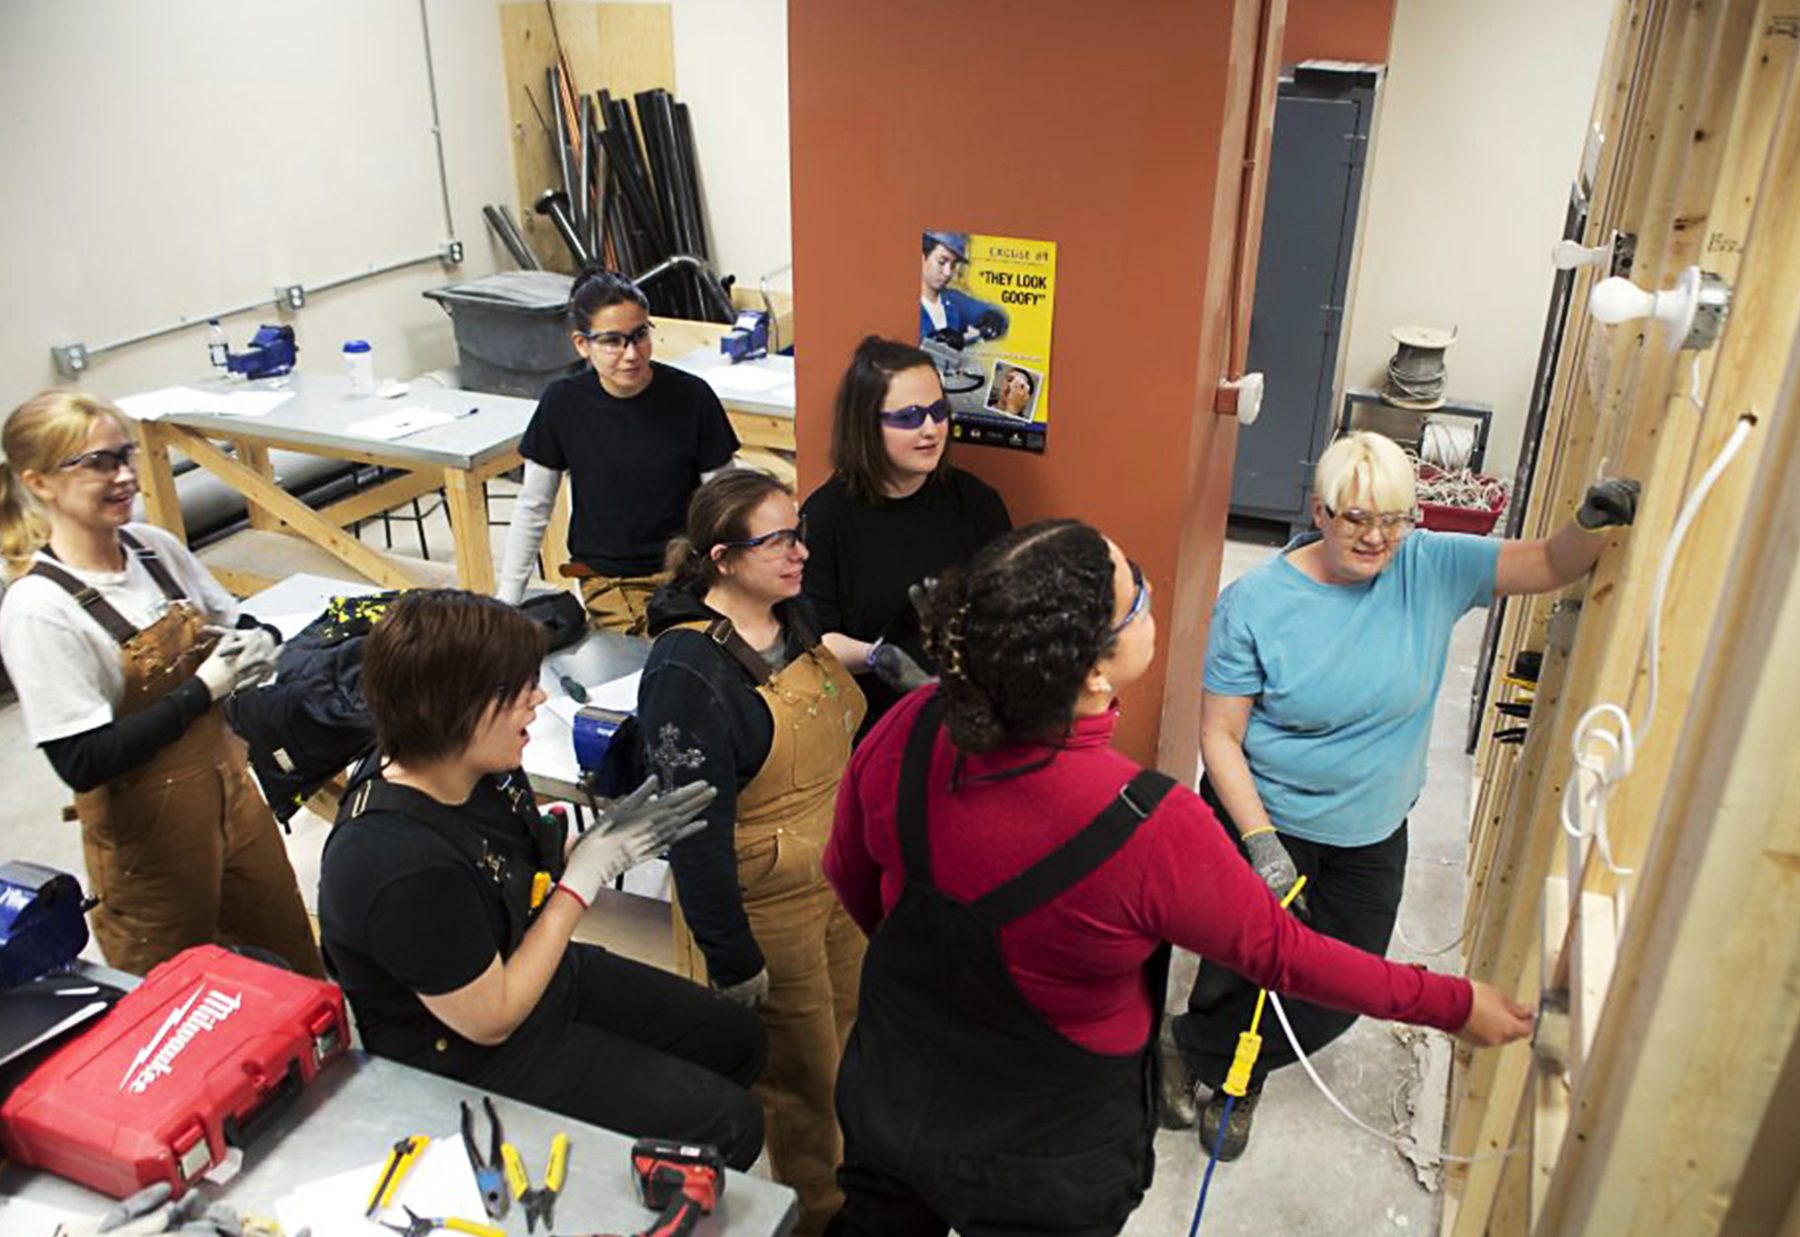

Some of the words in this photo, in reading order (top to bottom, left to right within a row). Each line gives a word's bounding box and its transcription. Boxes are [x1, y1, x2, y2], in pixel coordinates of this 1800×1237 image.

[989, 247, 1030, 260] EXCUSE
[1016, 273, 1047, 289] LOOK
[129, 990, 243, 1093] Milwaukee
